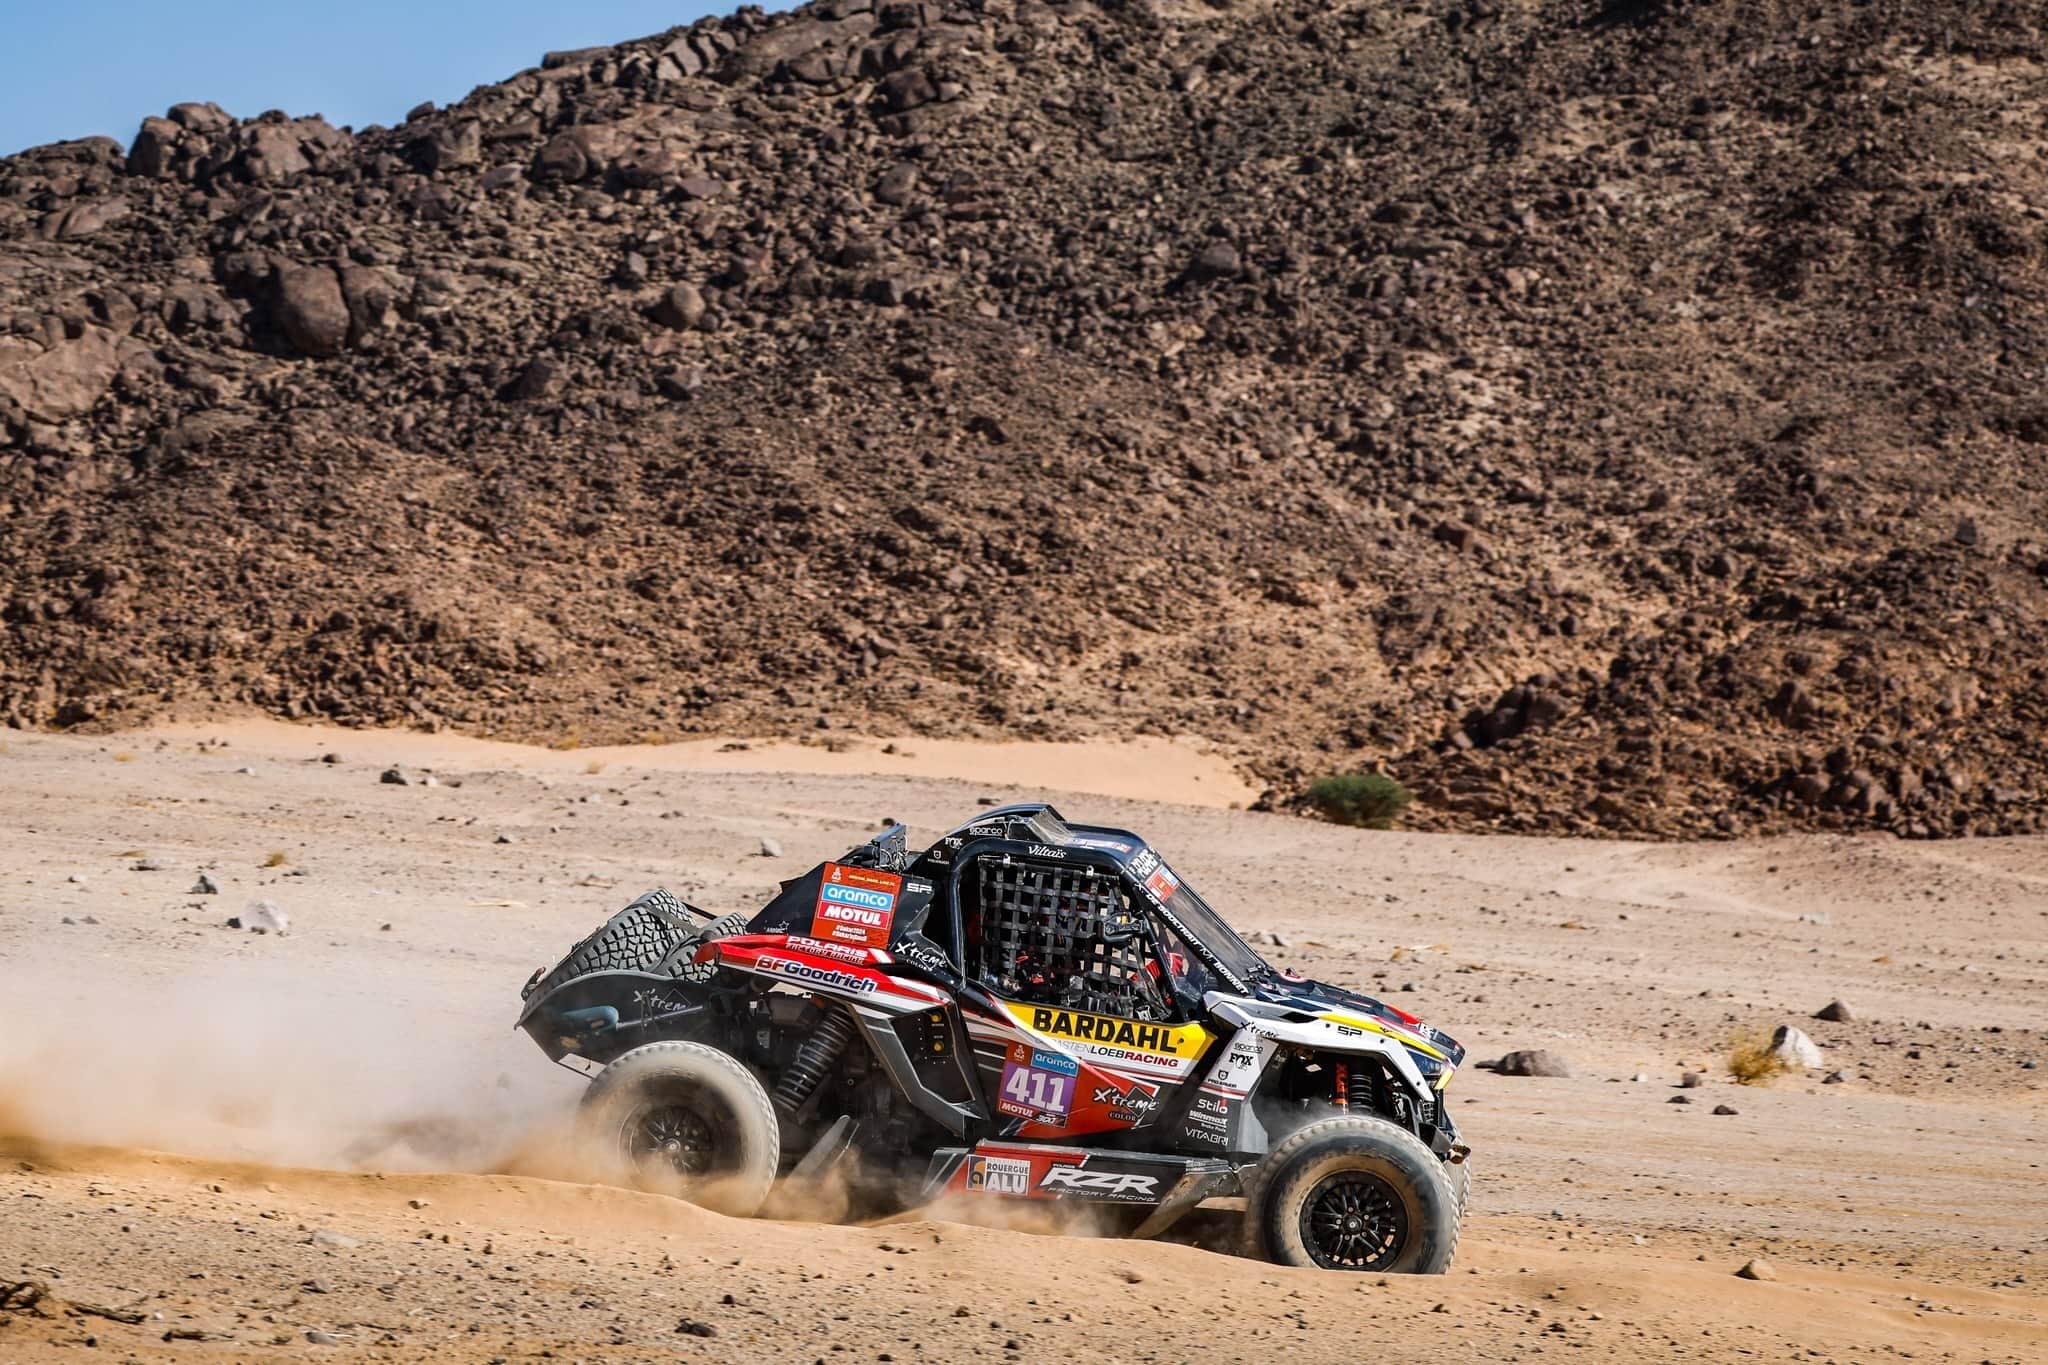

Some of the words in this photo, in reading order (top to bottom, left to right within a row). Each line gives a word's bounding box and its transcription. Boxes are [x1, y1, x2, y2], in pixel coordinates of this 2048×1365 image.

[969, 826, 1003, 837] sparco
[827, 887, 888, 907] aramco
[824, 905, 881, 926] MOTUL
[788, 935, 868, 958] POLARIS
[757, 956, 877, 992] BFGoodrich
[1032, 1008, 1177, 1053] BARDAHL
[1337, 1026, 1363, 1037] SP
[1233, 1042, 1264, 1054] sparco
[1035, 1051, 1076, 1070] aramco
[1229, 1052, 1253, 1066] FOX
[1006, 1067, 1065, 1112] 411
[1001, 1102, 1034, 1117] MOTUL
[1197, 1099, 1228, 1114] Stilo
[986, 1162, 1029, 1175] ROUERGUE
[985, 1175, 1026, 1194] ALU
[1039, 1167, 1160, 1195] RZR
[1047, 1187, 1105, 1198] FACTORY
[1107, 1192, 1156, 1202] RACING
